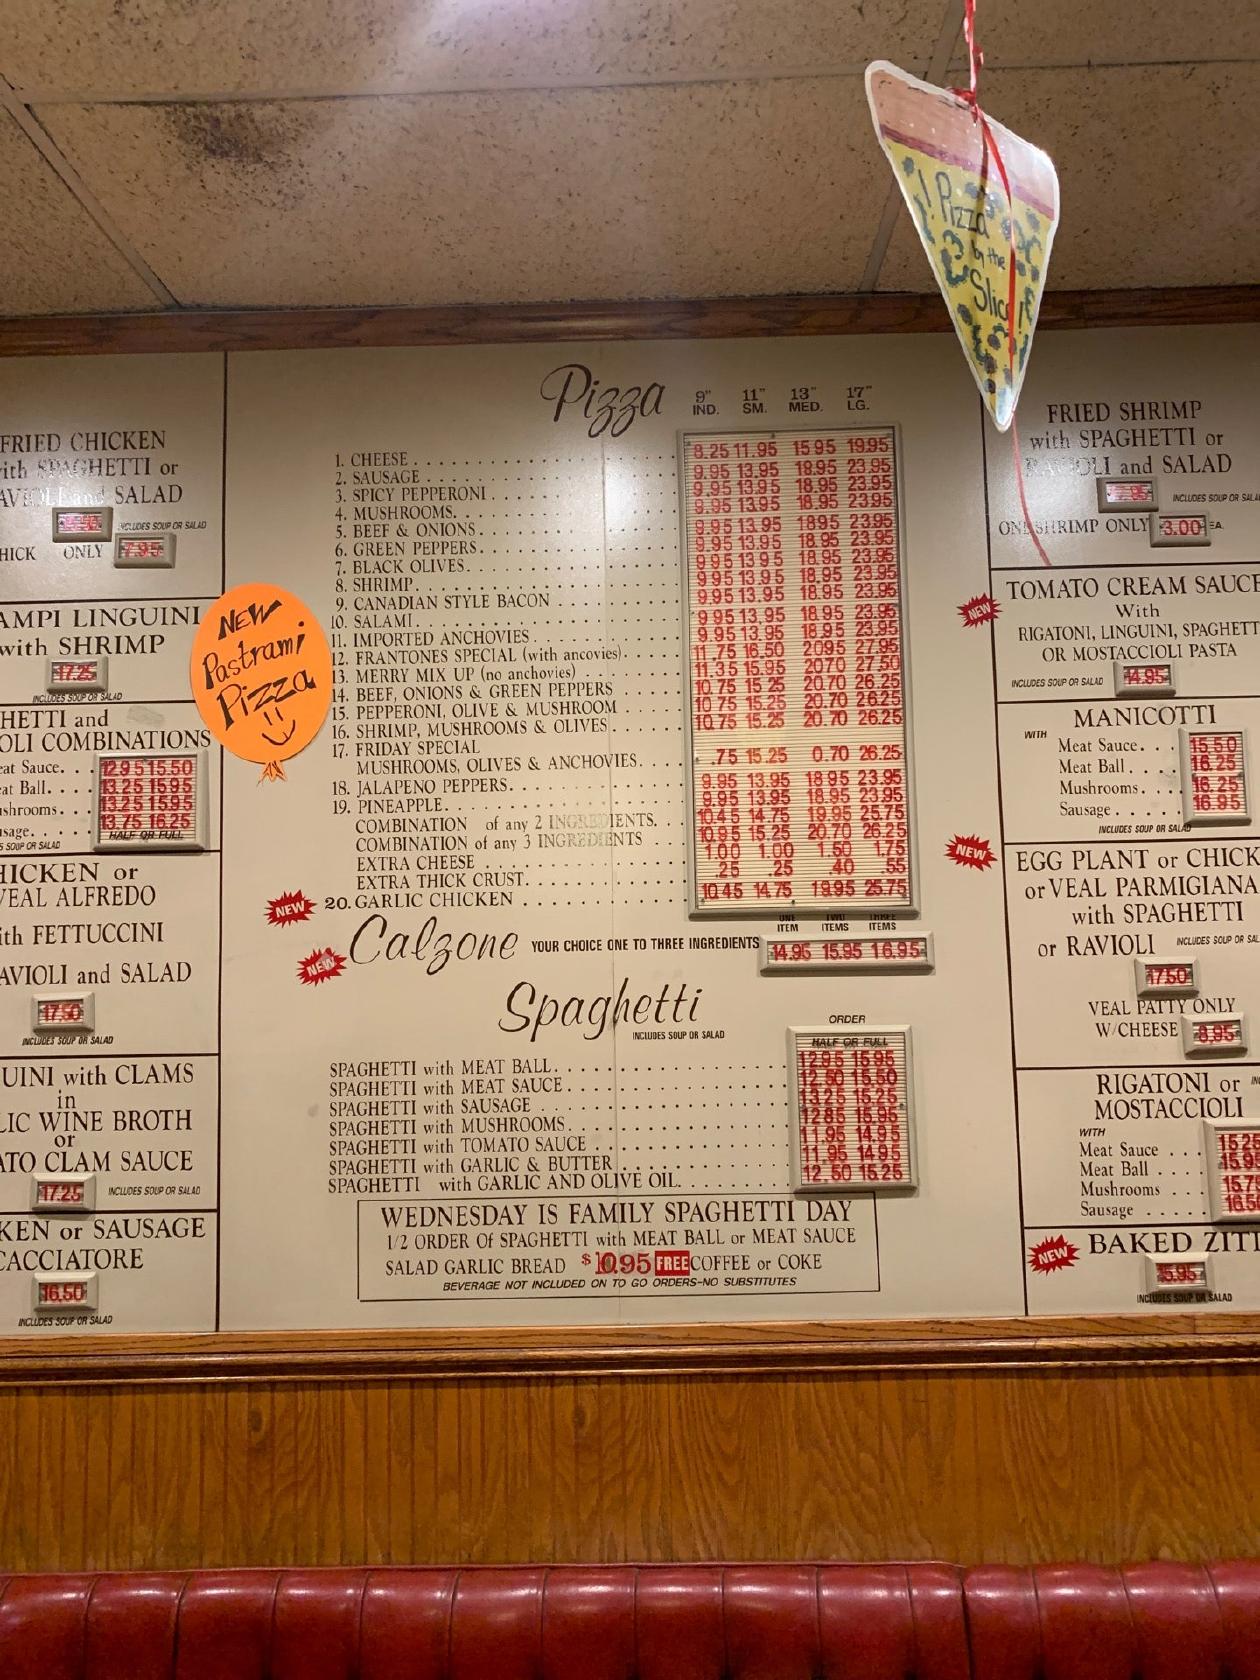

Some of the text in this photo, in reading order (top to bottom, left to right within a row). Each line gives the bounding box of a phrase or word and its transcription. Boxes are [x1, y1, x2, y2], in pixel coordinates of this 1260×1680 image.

[540, 363, 665, 438] Pizza
[692, 400, 870, 416] IND. SM. MED. LG.
[1047, 400, 1202, 423] FRIED SHRIMP
[1, 430, 167, 453] FRIED CHICKEN
[1080, 428, 1223, 448] SPAGHETTI or
[335, 451, 408, 468] 1. CHEESE
[335, 486, 486, 504] 3. SPICY PEPPERONI
[335, 540, 477, 557] 6. GREEN PEPPERS
[1006, 576, 1187, 600] TOMATO CREAM
[336, 593, 550, 612] 9. CANADIAN STYLE BACON
[968, 602, 991, 620] NEW
[1116, 604, 1160, 618] With
[74, 605, 202, 629] LINGUINI
[218, 600, 282, 641] NEW
[1019, 624, 1178, 641] RIGATONI, LINGUINI,
[59, 636, 165, 655] SHRIMP
[202, 621, 306, 690] Pastrami
[1042, 643, 1238, 662] OR MOSTACCIOLI PASTA
[331, 645, 622, 667] 12. FRANTONES SPECIAL (with ancovies)
[331, 663, 576, 685] 13. MERRY MIX UP (no anchovies)
[216, 668, 316, 731] Pizza
[1074, 705, 1216, 728] MANICOTTI
[331, 717, 608, 740] 16. SHRIMP, MUSHROOMS & OLIVES
[42, 729, 211, 751] COMBINATIONS
[1058, 737, 1137, 752] Meat Sauce
[356, 754, 637, 776] MUSHROOMS, OLIVES & ANCHOVIES
[332, 777, 507, 797] 18. JALAPENO PEPPERS
[1060, 801, 1111, 818] Sausage
[956, 844, 987, 861] NEW
[1016, 849, 1179, 871] EGG PLANT or
[57, 885, 156, 906] ALFREDO
[325, 891, 514, 911] 20. GARLIC CHICKEN
[275, 901, 305, 917] NEW
[33, 921, 164, 945] FETTUCCINI
[777, 921, 896, 932] ITEM ITEMS ITEMS
[350, 914, 760, 976] Calzone YOUR CHOICE ONE TO THREE INGREDIENTS
[1066, 933, 1156, 956] RAVIOLI
[77, 961, 192, 984] and SALAD
[305, 955, 336, 972] NEW
[499, 978, 701, 1042] Spaghetti
[1088, 998, 1236, 1016] VEAL PATTY ONLY
[829, 1015, 866, 1024] ORDER
[633, 1030, 725, 1041] INCLUDES SOUP OR SALAD
[1096, 1022, 1178, 1038] W/CHEESE
[64, 1063, 194, 1086] with CLAMS
[330, 1058, 552, 1078] SPAGHETTI with MEAT BALL
[39, 1109, 193, 1132] WINE BROTH
[328, 1172, 677, 1194] SPAGHETTI with GARLIC AND OLIVE OIL
[381, 1199, 854, 1230] WEDNESDAY IS FAMILY SPAGHETTI DAY
[1037, 1232, 1192, 1264] NEW BAKED
[656, 1254, 690, 1272] FREE
[443, 1279, 501, 1292] BEVERAGE
[504, 1280, 528, 1290] NOT
[531, 1278, 588, 1289] INCLUDED
[591, 1278, 608, 1288] ON
[611, 1278, 627, 1287] TO
[630, 1277, 648, 1287] GO
[723, 1275, 797, 1286] SUBSTITUTES
